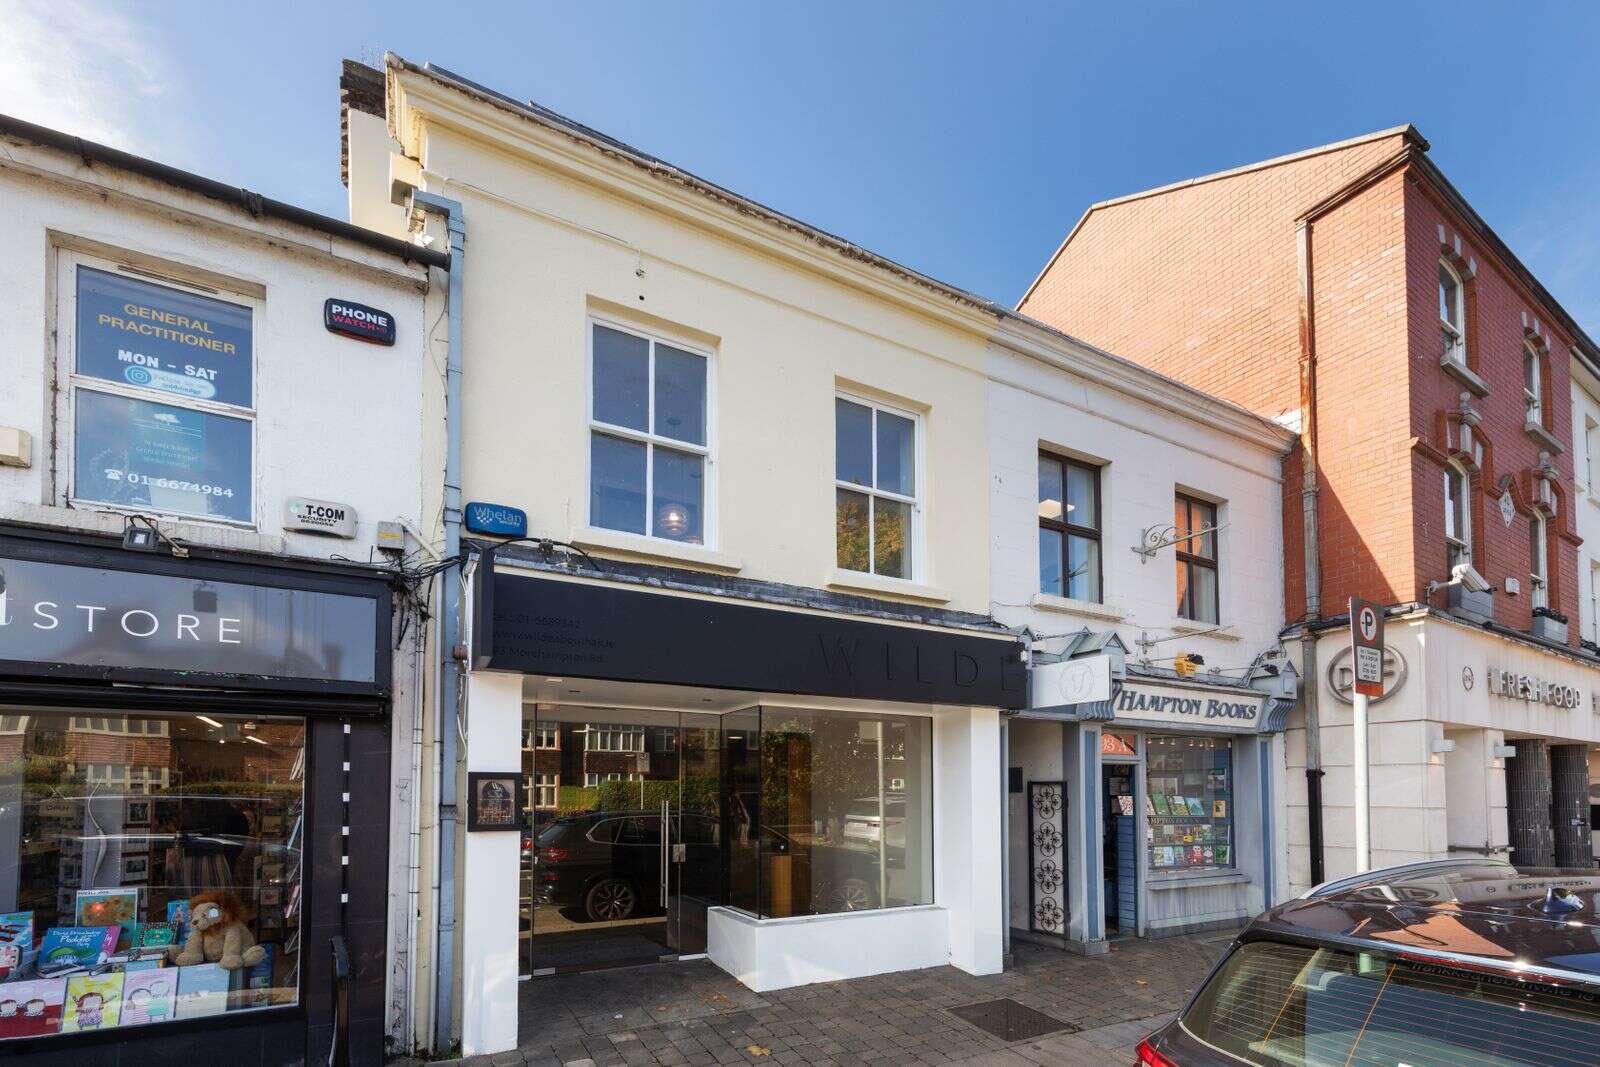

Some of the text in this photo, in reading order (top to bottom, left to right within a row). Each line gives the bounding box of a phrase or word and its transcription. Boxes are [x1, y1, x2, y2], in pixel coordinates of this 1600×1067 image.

[123, 303, 214, 334] GENERAL
[332, 304, 388, 327] PHONE
[98, 314, 236, 354] PRACTITIONER
[118, 350, 159, 368] MON
[184, 365, 218, 381] SAT
[127, 473, 234, 498] 01 6674984
[306, 505, 345, 521] T-COM
[473, 505, 522, 523] Whelan
[33, 601, 241, 644] STORE
[1364, 611, 1373, 637] P
[818, 632, 1020, 692] WILDE
[1546, 684, 1582, 708] FOOD
